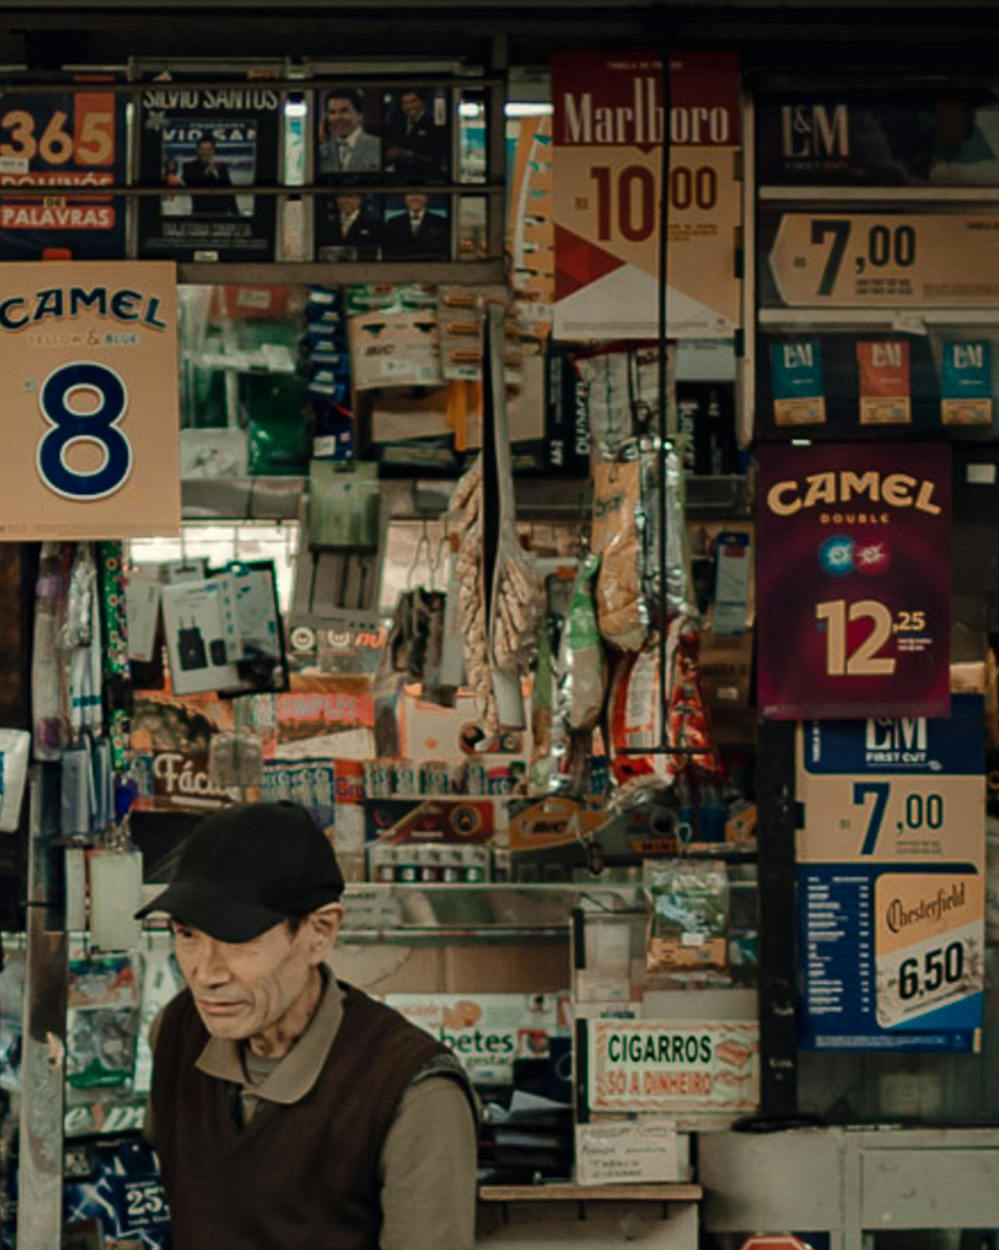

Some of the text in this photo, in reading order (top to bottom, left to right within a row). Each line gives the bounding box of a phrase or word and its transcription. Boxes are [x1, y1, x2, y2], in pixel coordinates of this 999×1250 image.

[203, 88, 278, 111] SANTOS
[563, 77, 730, 144] Marlboro
[781, 104, 850, 160] L&M
[1, 207, 110, 227] PALAVRAS
[811, 220, 916, 297] 7,00
[37, 362, 133, 500] 8
[766, 470, 942, 516] CAMEL
[818, 512, 890, 524] DOUBLE
[866, 752, 926, 763] FIRST CUT
[853, 781, 943, 856] 7,00
[886, 881, 965, 934] Chesterfield
[899, 941, 964, 1001] 6,50
[609, 1035, 712, 1063] CIGARROS
[629, 1072, 641, 1094] A
[645, 1072, 712, 1095] DINHEIRO
